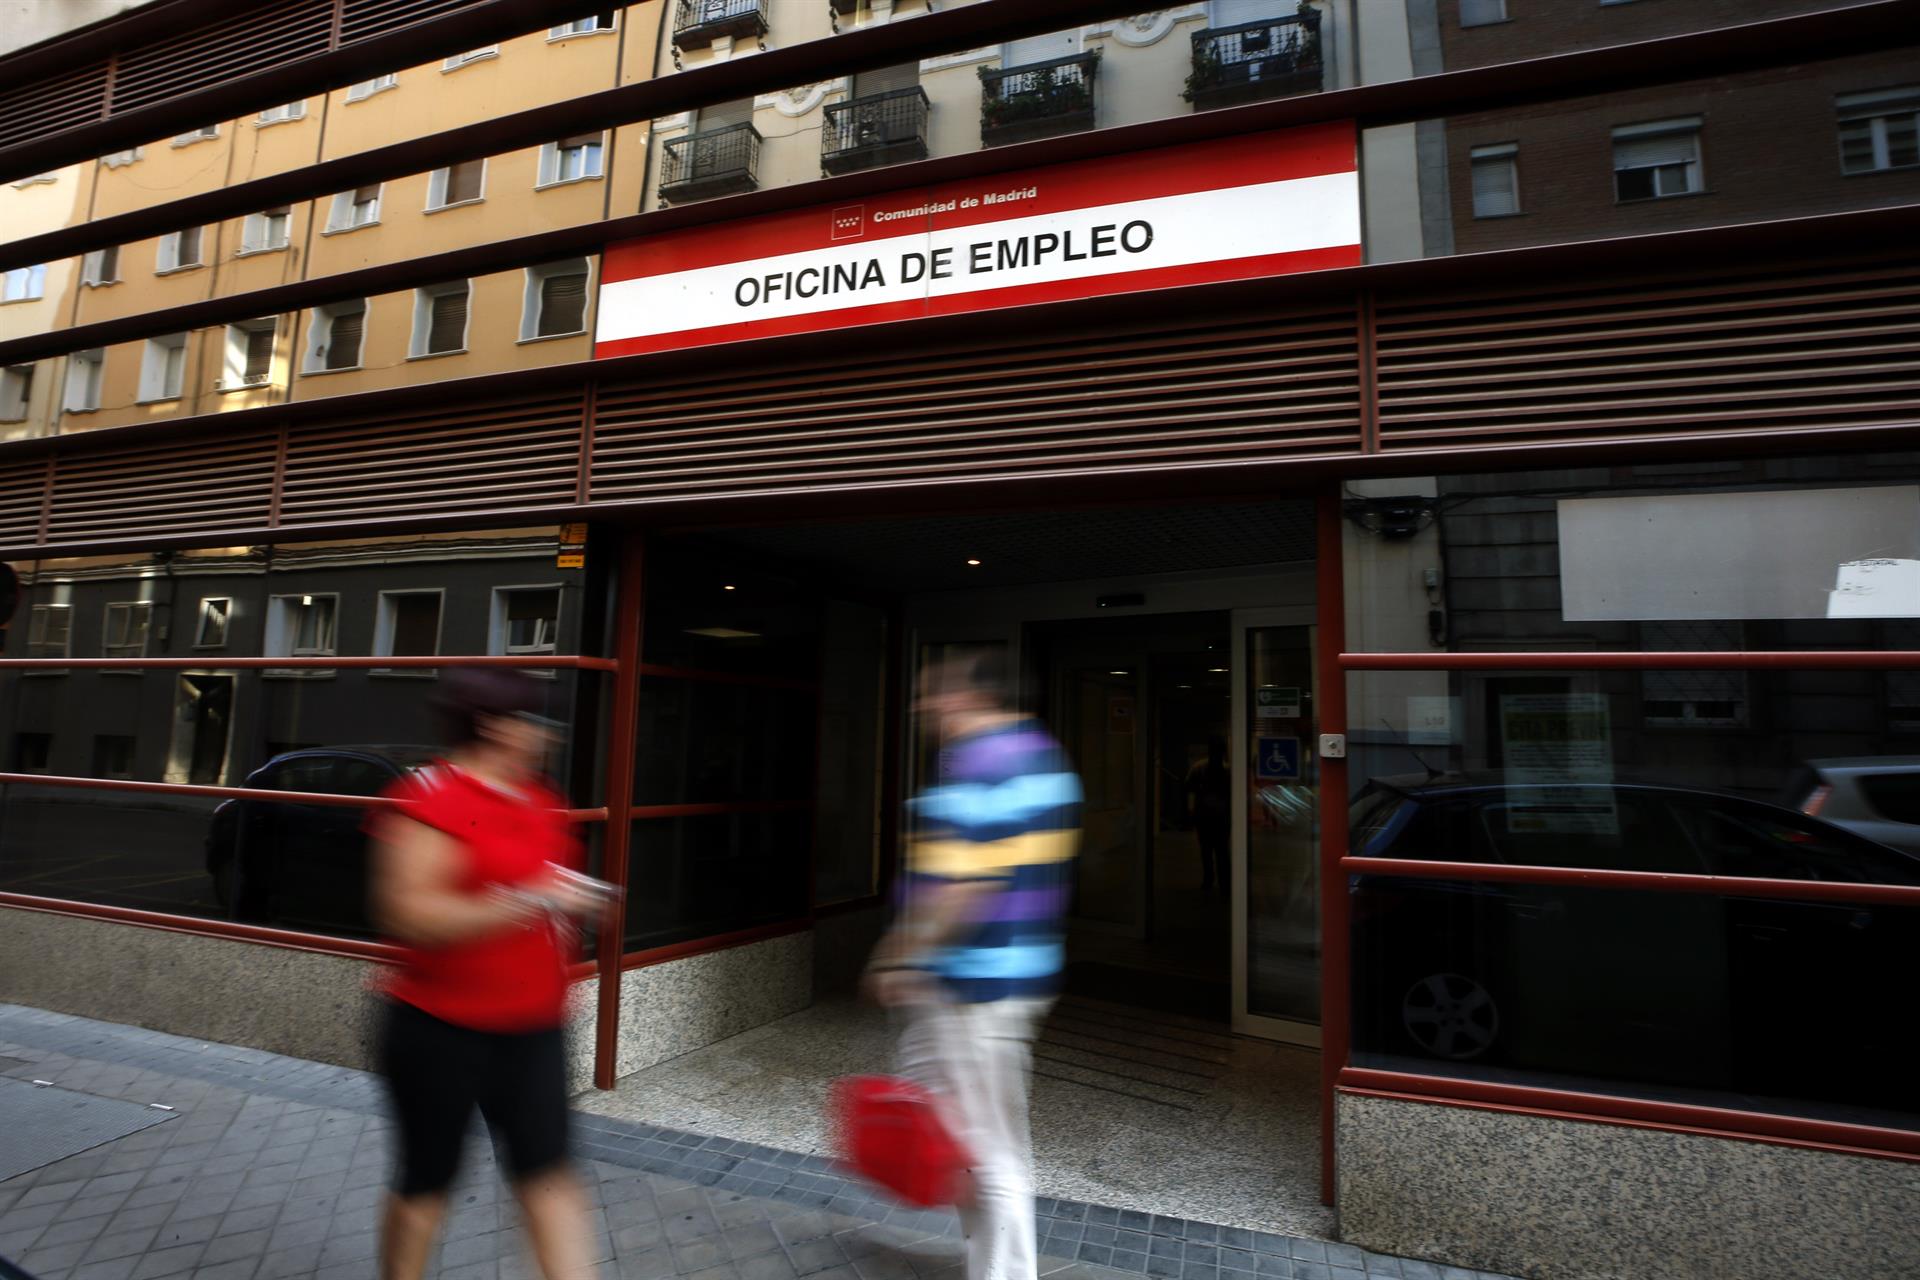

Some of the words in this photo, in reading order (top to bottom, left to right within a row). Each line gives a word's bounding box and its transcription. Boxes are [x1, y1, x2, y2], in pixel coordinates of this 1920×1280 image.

[873, 200, 956, 222] Comunidad
[960, 197, 979, 209] de
[983, 187, 1037, 205] Madrid
[735, 258, 886, 307] OFICINA
[901, 247, 953, 284] DE
[969, 219, 1154, 274] EMPLEO
